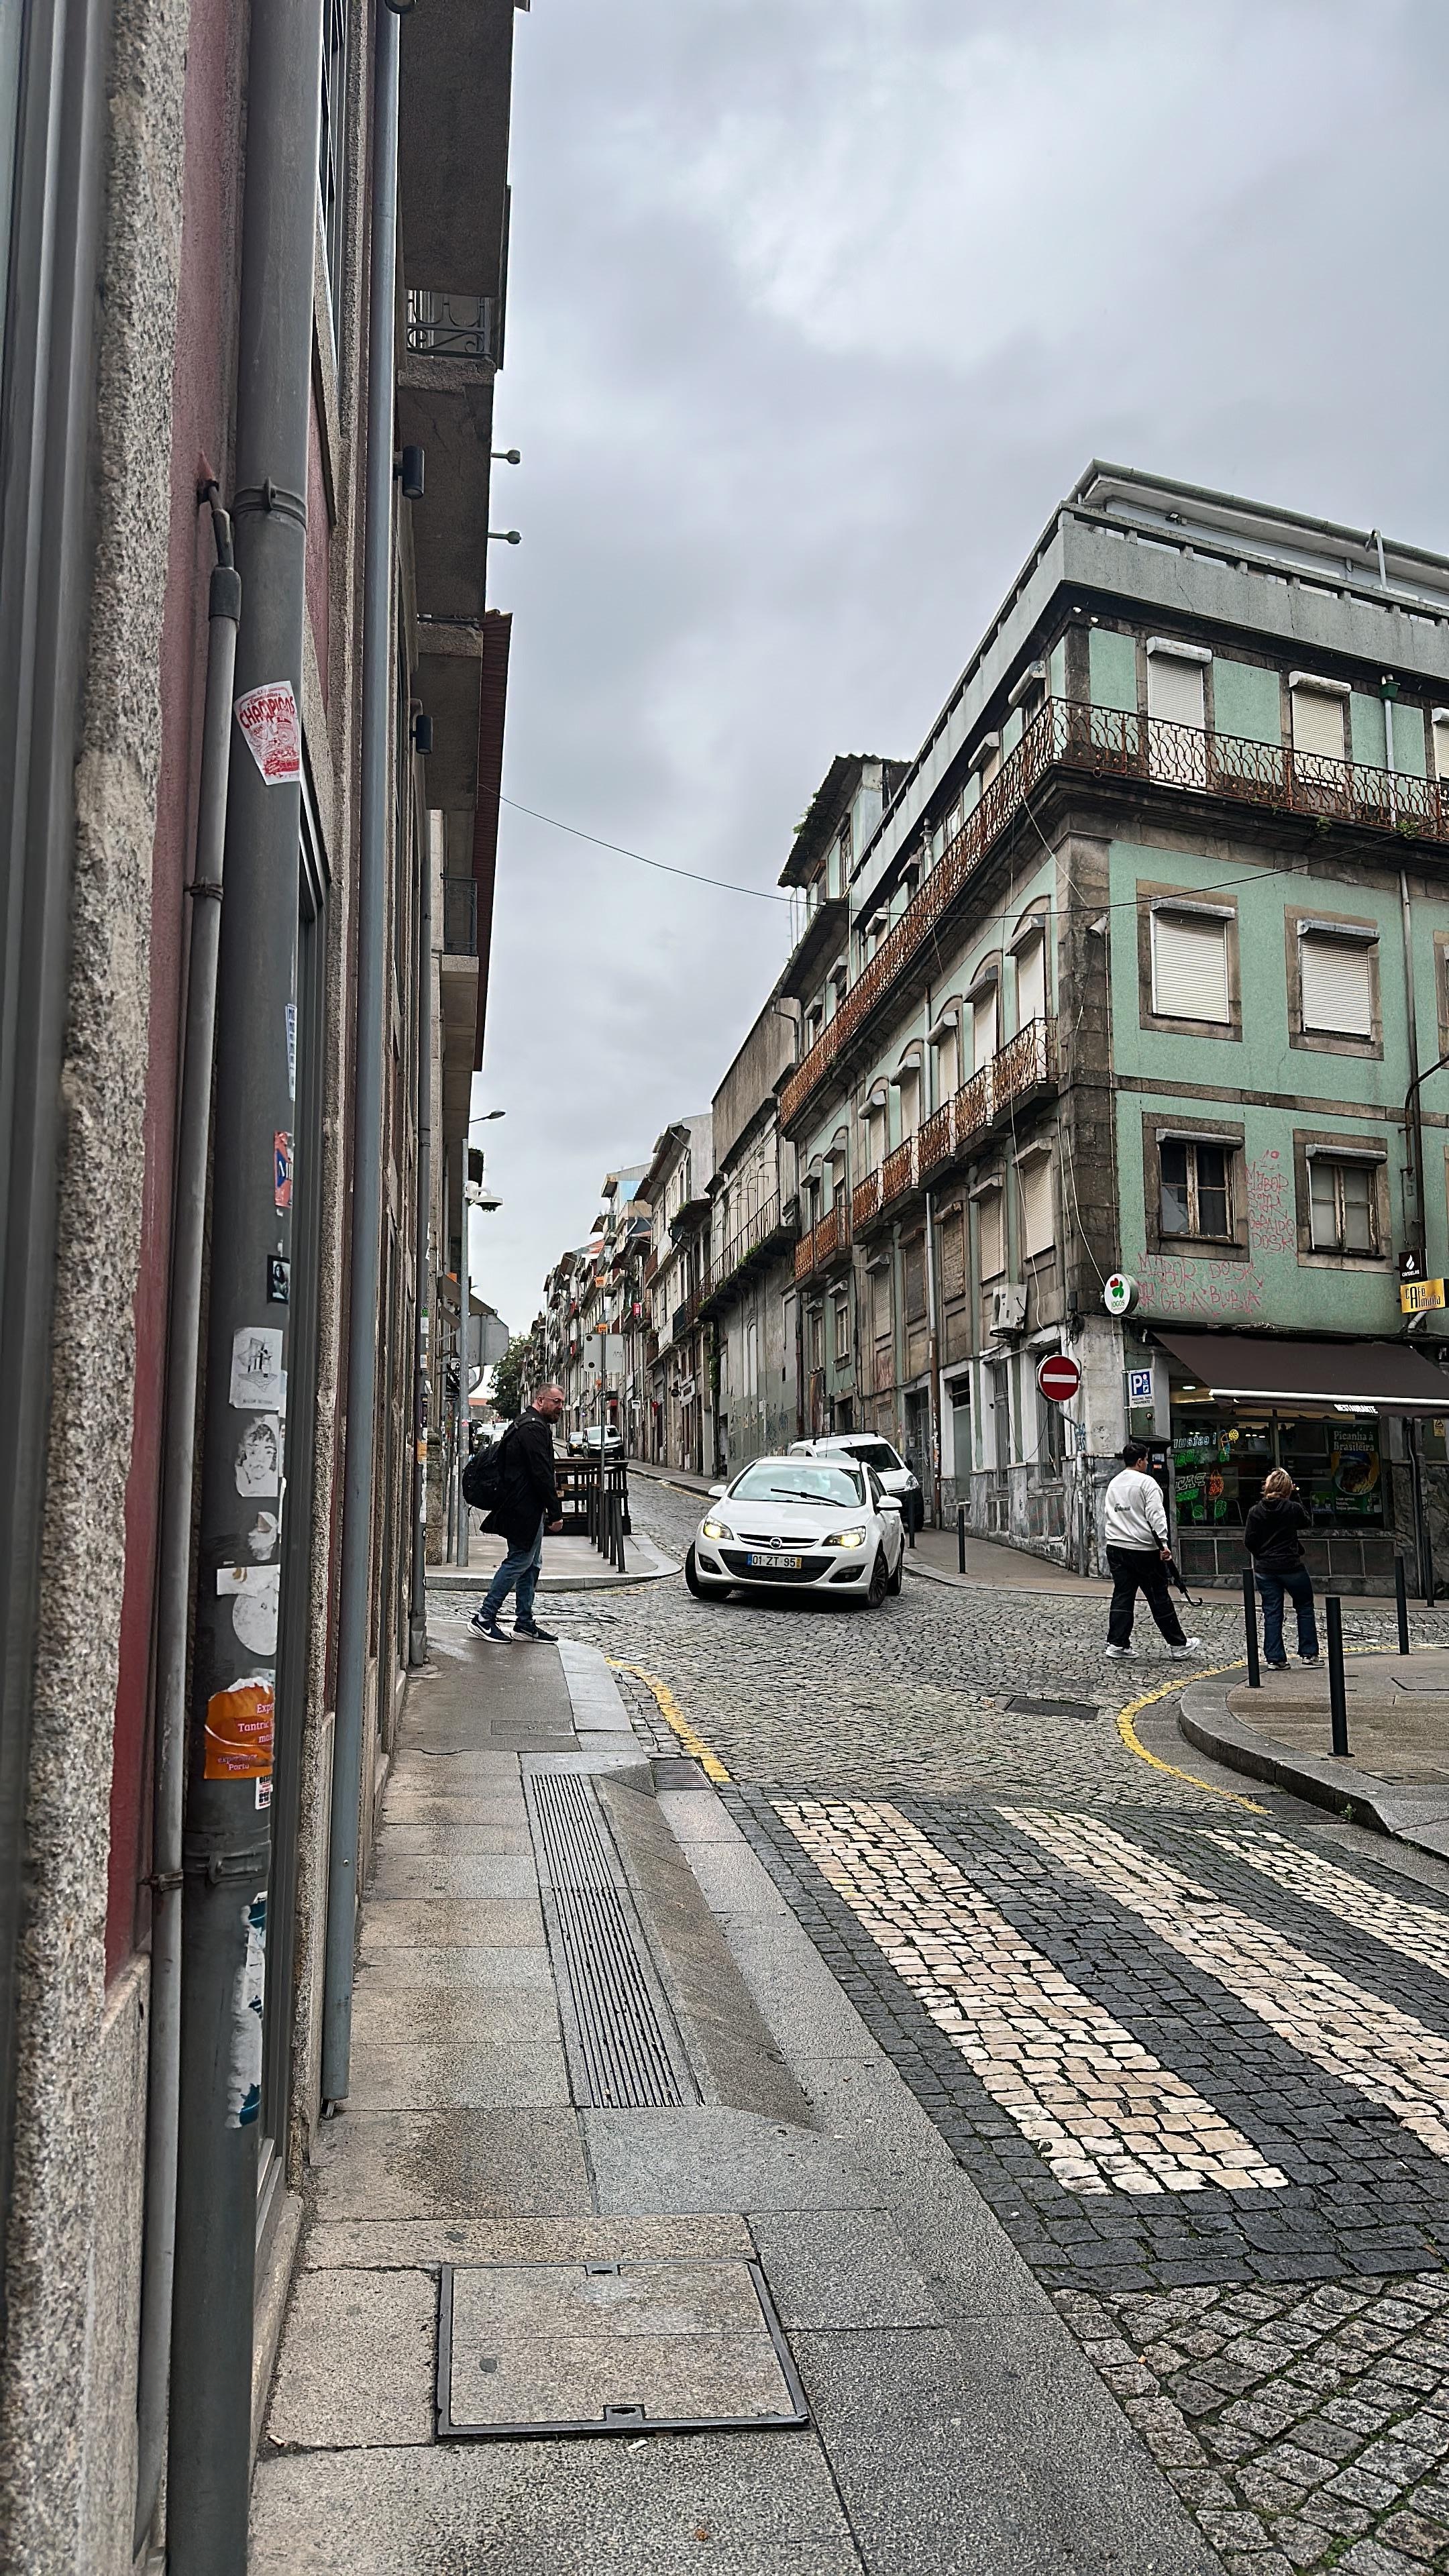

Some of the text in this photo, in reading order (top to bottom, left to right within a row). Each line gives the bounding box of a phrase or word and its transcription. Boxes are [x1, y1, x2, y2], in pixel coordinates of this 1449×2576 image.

[1111, 1299, 1125, 1310] JOGOS
[1133, 1375, 1142, 1394] P
[1334, 1403, 1379, 1414] RESTAURANTE
[1334, 1428, 1366, 1441] Picanha
[1334, 1441, 1375, 1451] Brasileira
[753, 1555, 761, 1565] 01
[766, 1556, 779, 1566] ZT
[784, 1557, 796, 1567] 95
[238, 1721, 269, 1732] Tantric
